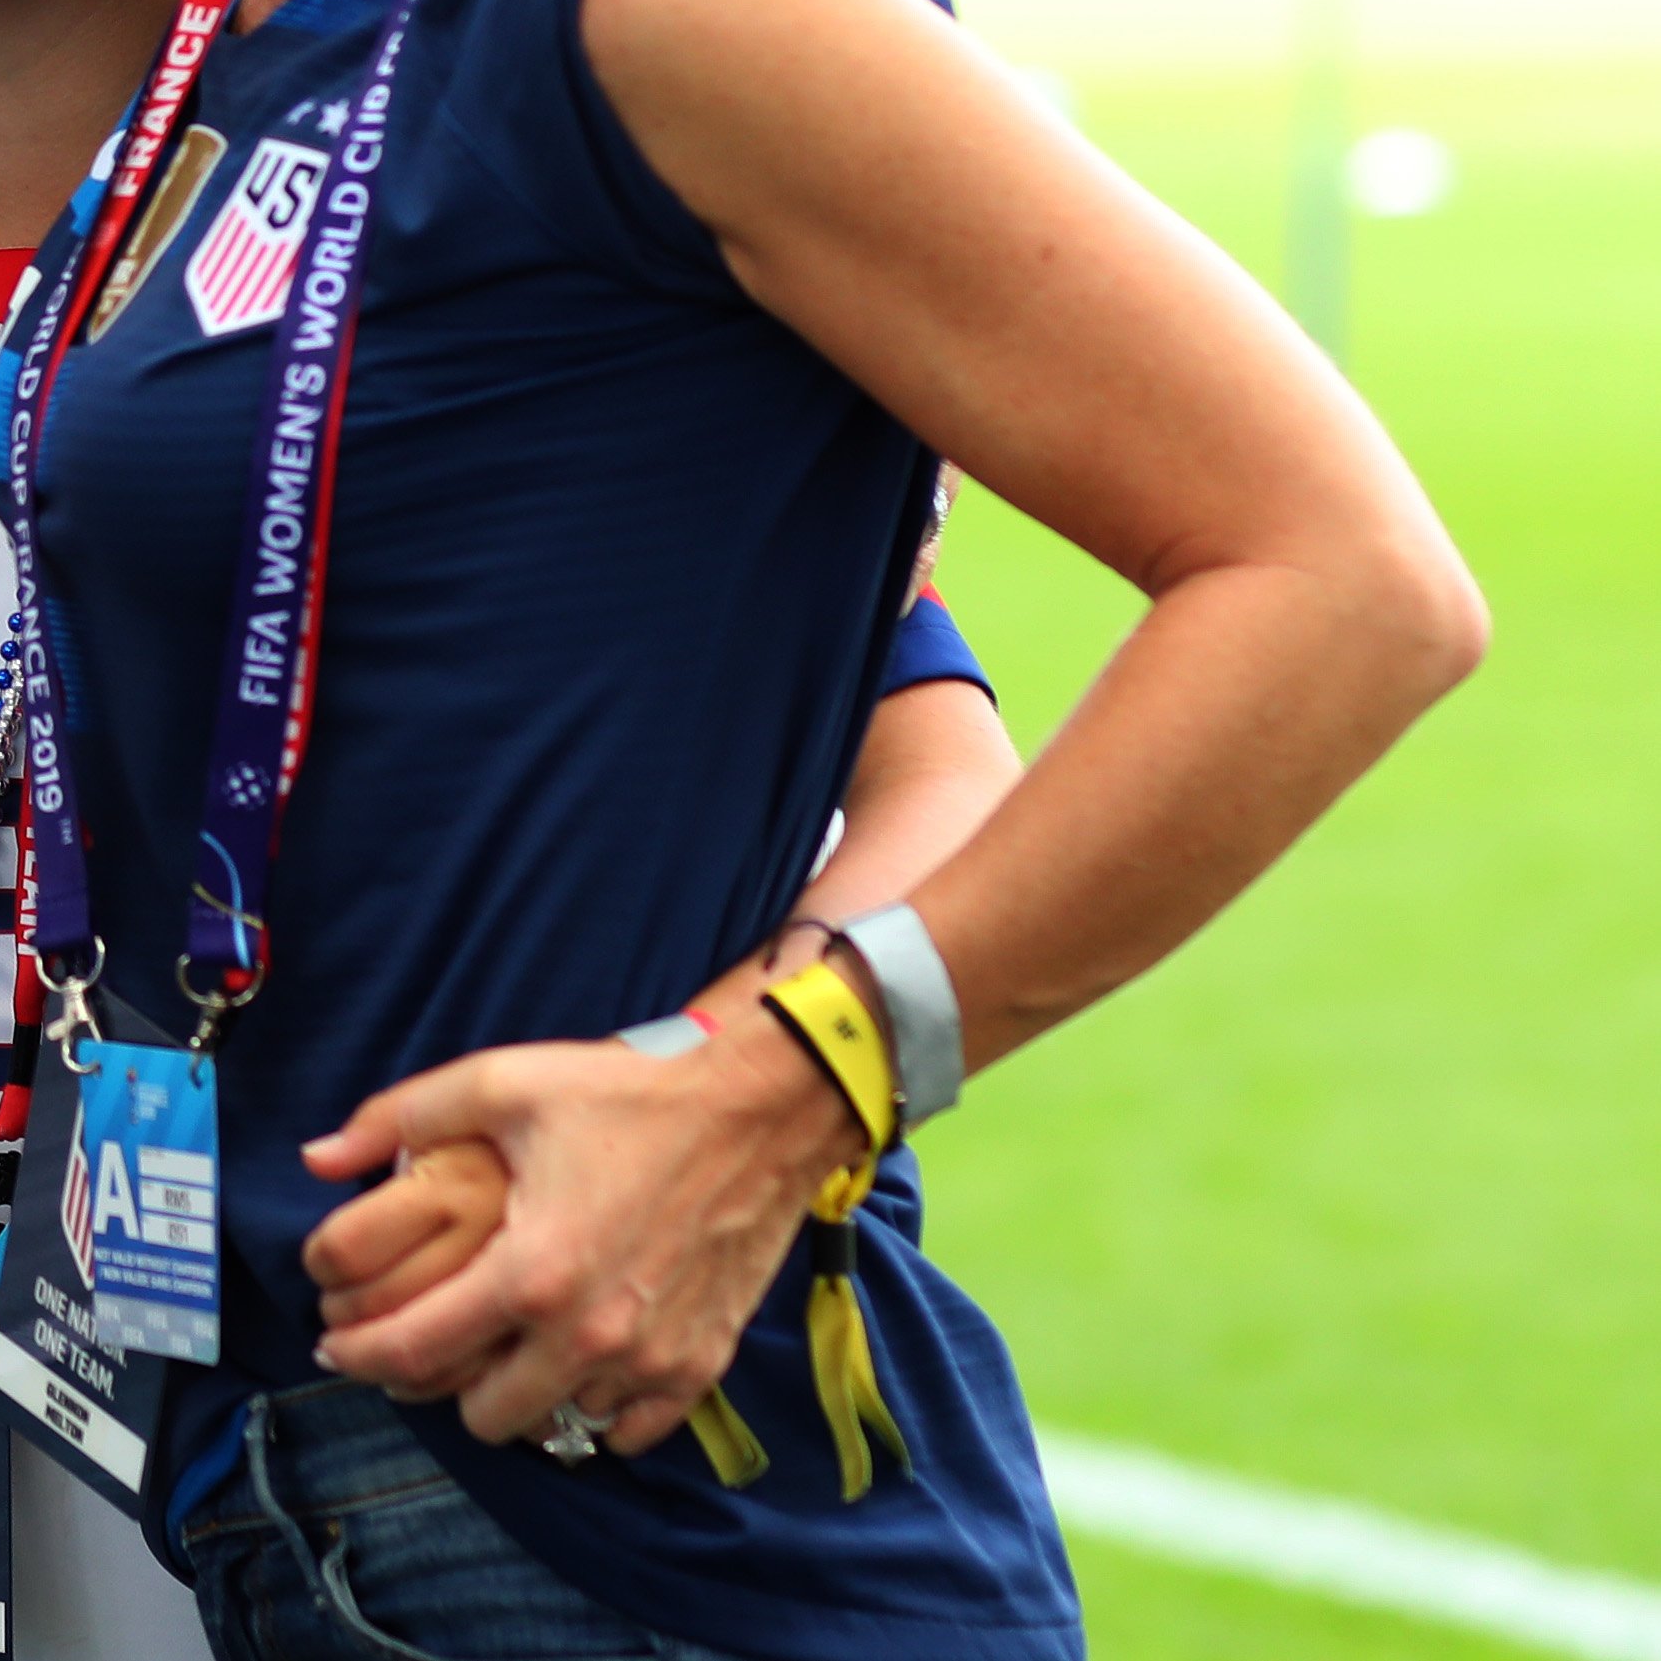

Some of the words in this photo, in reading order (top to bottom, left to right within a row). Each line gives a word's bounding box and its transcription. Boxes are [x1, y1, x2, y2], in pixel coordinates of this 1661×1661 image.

[111, 0, 223, 201] FRANCE
[341, 82, 392, 175] CUP
[245, 150, 323, 231] US
[290, 181, 371, 353] WORLD
[10, 408, 33, 507] CUP
[252, 360, 328, 599] WOMEN'S
[12, 518, 53, 705] FRANCE
[237, 608, 293, 707] FIFA
[29, 713, 65, 816] 2019
[93, 1139, 140, 1241] A
[34, 1275, 68, 1322] ONE
[34, 1317, 68, 1364] ONE
[70, 1344, 115, 1401] TEAM.
